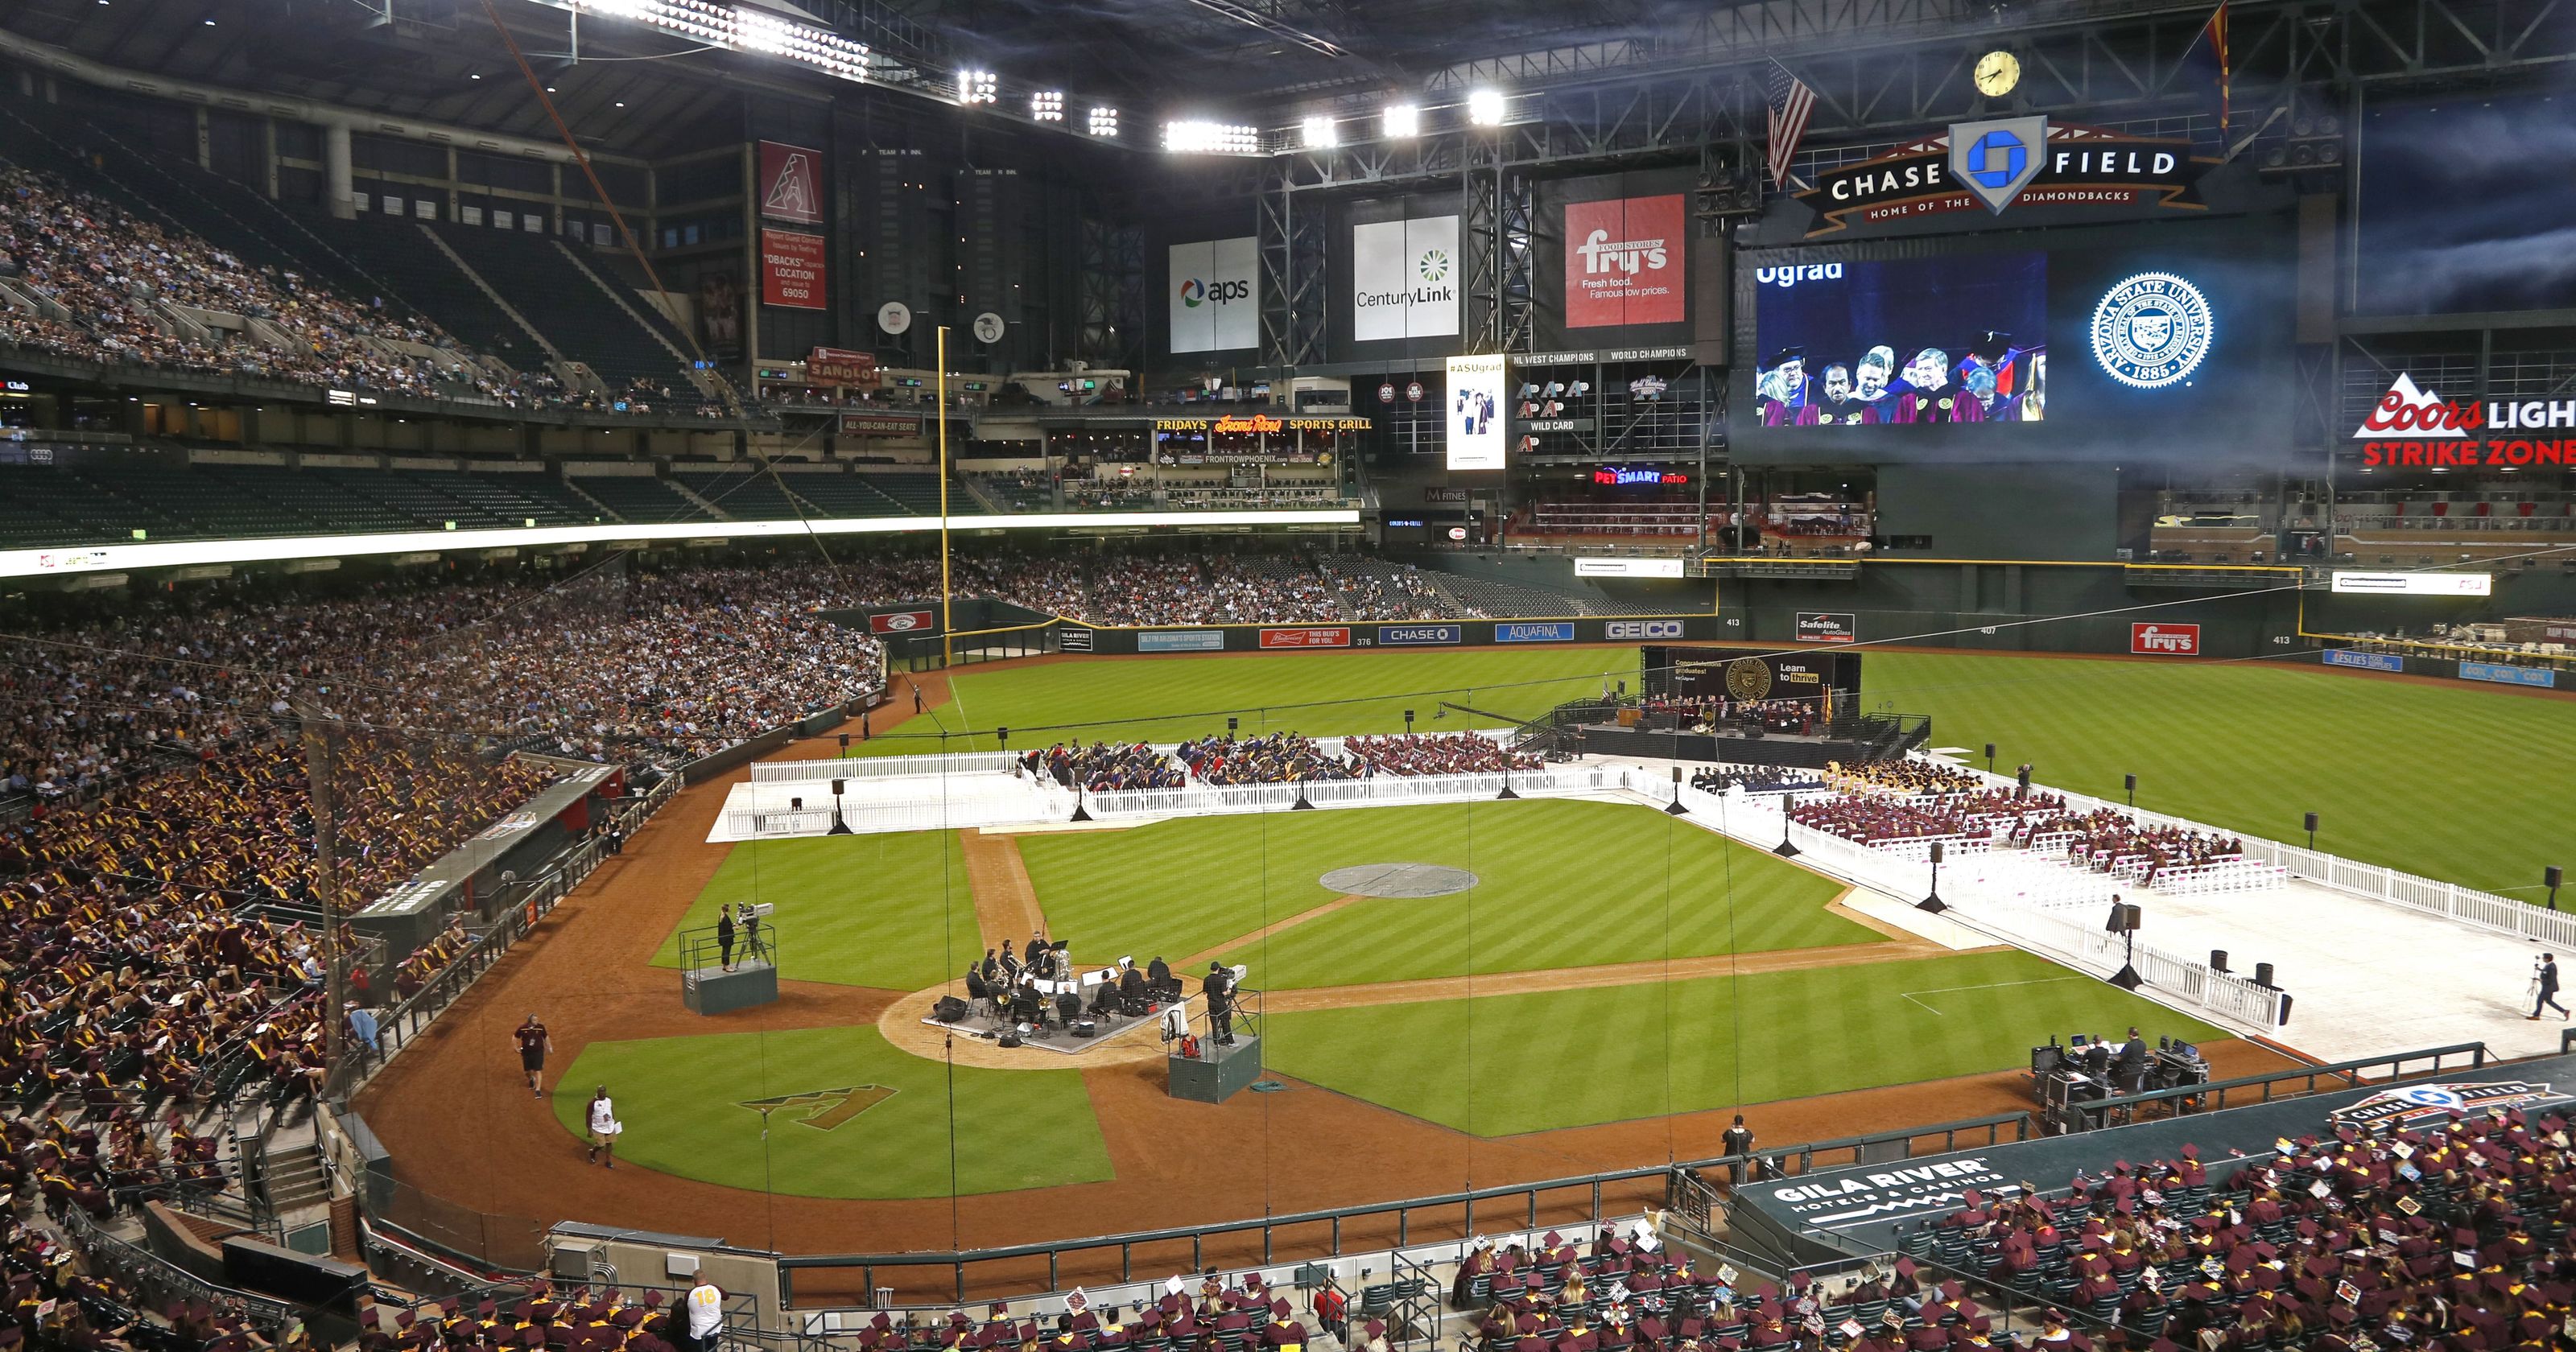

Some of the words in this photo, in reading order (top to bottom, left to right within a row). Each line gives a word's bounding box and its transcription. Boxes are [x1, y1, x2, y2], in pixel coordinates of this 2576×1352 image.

[1831, 163, 1940, 200] CHASE
[2056, 152, 2174, 175] FIELD
[1870, 205, 1908, 219] HOME
[1918, 202, 1934, 212] OF
[1946, 199, 1970, 208] THE
[2023, 192, 2130, 202] DIAMONDBACKS
[766, 232, 784, 241] Report
[785, 233, 800, 243] Guest
[802, 235, 823, 245] Conduct
[773, 241, 790, 251] Issues
[791, 244, 797, 252] by
[798, 245, 817, 254] Texting
[1576, 229, 1667, 274] fry's
[1600, 243, 1622, 251] FOOD
[1626, 241, 1660, 249] STORES
[775, 268, 815, 280] LOCATION
[1583, 279, 1607, 288] Fresh
[1610, 277, 1633, 286] food.
[782, 287, 809, 299] 69050
[1208, 279, 1249, 305] aps
[1356, 286, 1451, 307] CenturyLink
[1591, 289, 1623, 299] Famous
[1624, 287, 1640, 295] low
[1641, 286, 1670, 297] prices.
[2099, 306, 2128, 369] ARIZONA
[2116, 281, 2165, 306] STATE
[2168, 283, 2204, 369] UNIVERSITY
[1513, 356, 1523, 365] NL
[1525, 355, 1546, 364] WEST
[1548, 352, 1594, 363] CHAMPIONS
[1611, 350, 1637, 360] WORLD
[1640, 348, 1686, 359] CHAMPIONS
[1450, 363, 1502, 373] #ASUgrad
[2132, 365, 2169, 380] 1885
[7, 381, 29, 390] Club
[2363, 390, 2485, 431] Coors
[846, 422, 898, 431] ALL-YOU-CAN-EAT
[898, 423, 916, 431] SEATS
[1215, 414, 1253, 433] Front
[1253, 414, 1282, 432] Row
[1290, 419, 1335, 430] SPORTS
[1339, 419, 1372, 429] GRILL
[1531, 422, 1551, 431] WILD
[1553, 421, 1574, 430] CARD
[2363, 441, 2479, 466] STRIKE
[2486, 439, 2576, 465] ZONE
[1205, 455, 1288, 464] FRONTROWPHOENIX.com
[1595, 470, 1661, 484] PETSMART
[1662, 475, 1687, 483] PATIO
[1442, 492, 1466, 501] FITNES
[1607, 621, 1682, 637] GEICO
[1800, 620, 1840, 629] Safelite
[1391, 630, 1435, 640] CHASE
[1509, 624, 1559, 639] AQUAFINA
[2139, 625, 2192, 651] fry's
[1781, 663, 1806, 673] Learn
[1781, 674, 1790, 682] to
[1792, 674, 1817, 682] thrive
[2351, 1101, 2413, 1119] CHASE
[2460, 1085, 2529, 1098] FIELD
[1774, 1178, 1873, 1202] GILA
[1866, 1159, 1990, 1188] RIVER
[1791, 1194, 1878, 1213] HOTELS
[1910, 1173, 2004, 1193] CASINOS
[695, 1288, 716, 1307] 18
